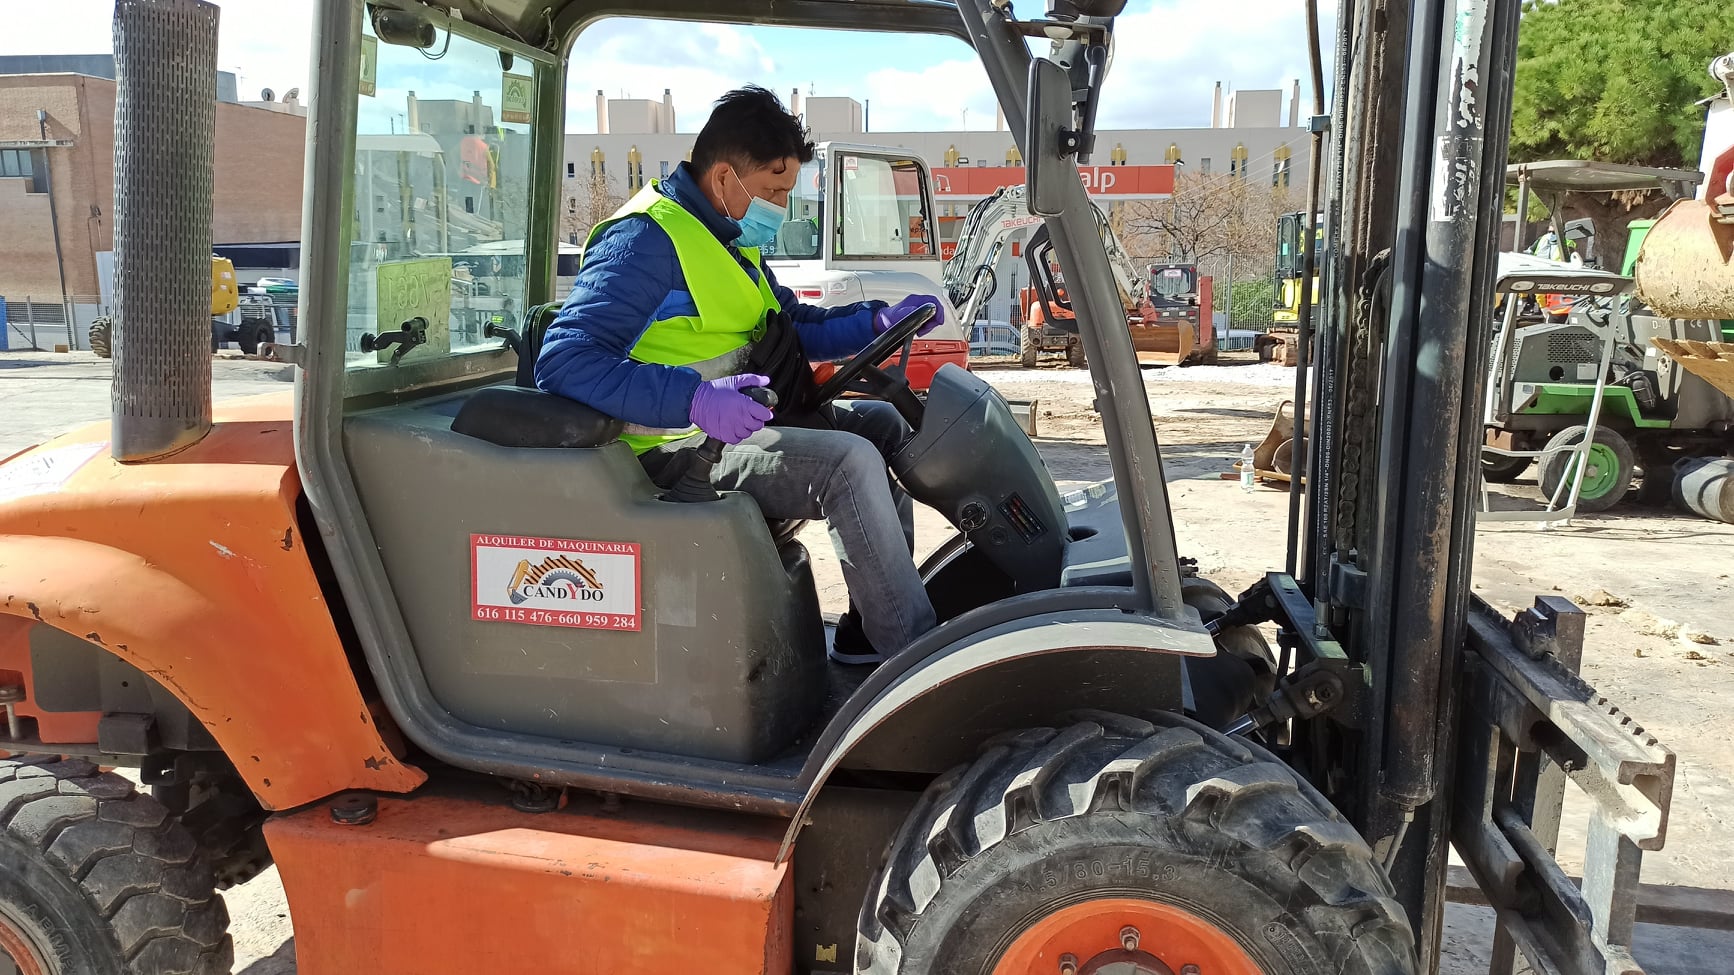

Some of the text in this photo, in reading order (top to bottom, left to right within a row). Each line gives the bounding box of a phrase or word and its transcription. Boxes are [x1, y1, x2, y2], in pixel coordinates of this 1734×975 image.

[1080, 167, 1116, 193] alp
[1537, 283, 1591, 291] TAKEUCHI
[476, 536, 634, 553] ALQUILER DE MAQUINARIA
[523, 583, 604, 602] CANDYDO
[477, 608, 635, 628] 616 115 476-660 959 284
[1009, 856, 1177, 896] 1.5/80-15.3
